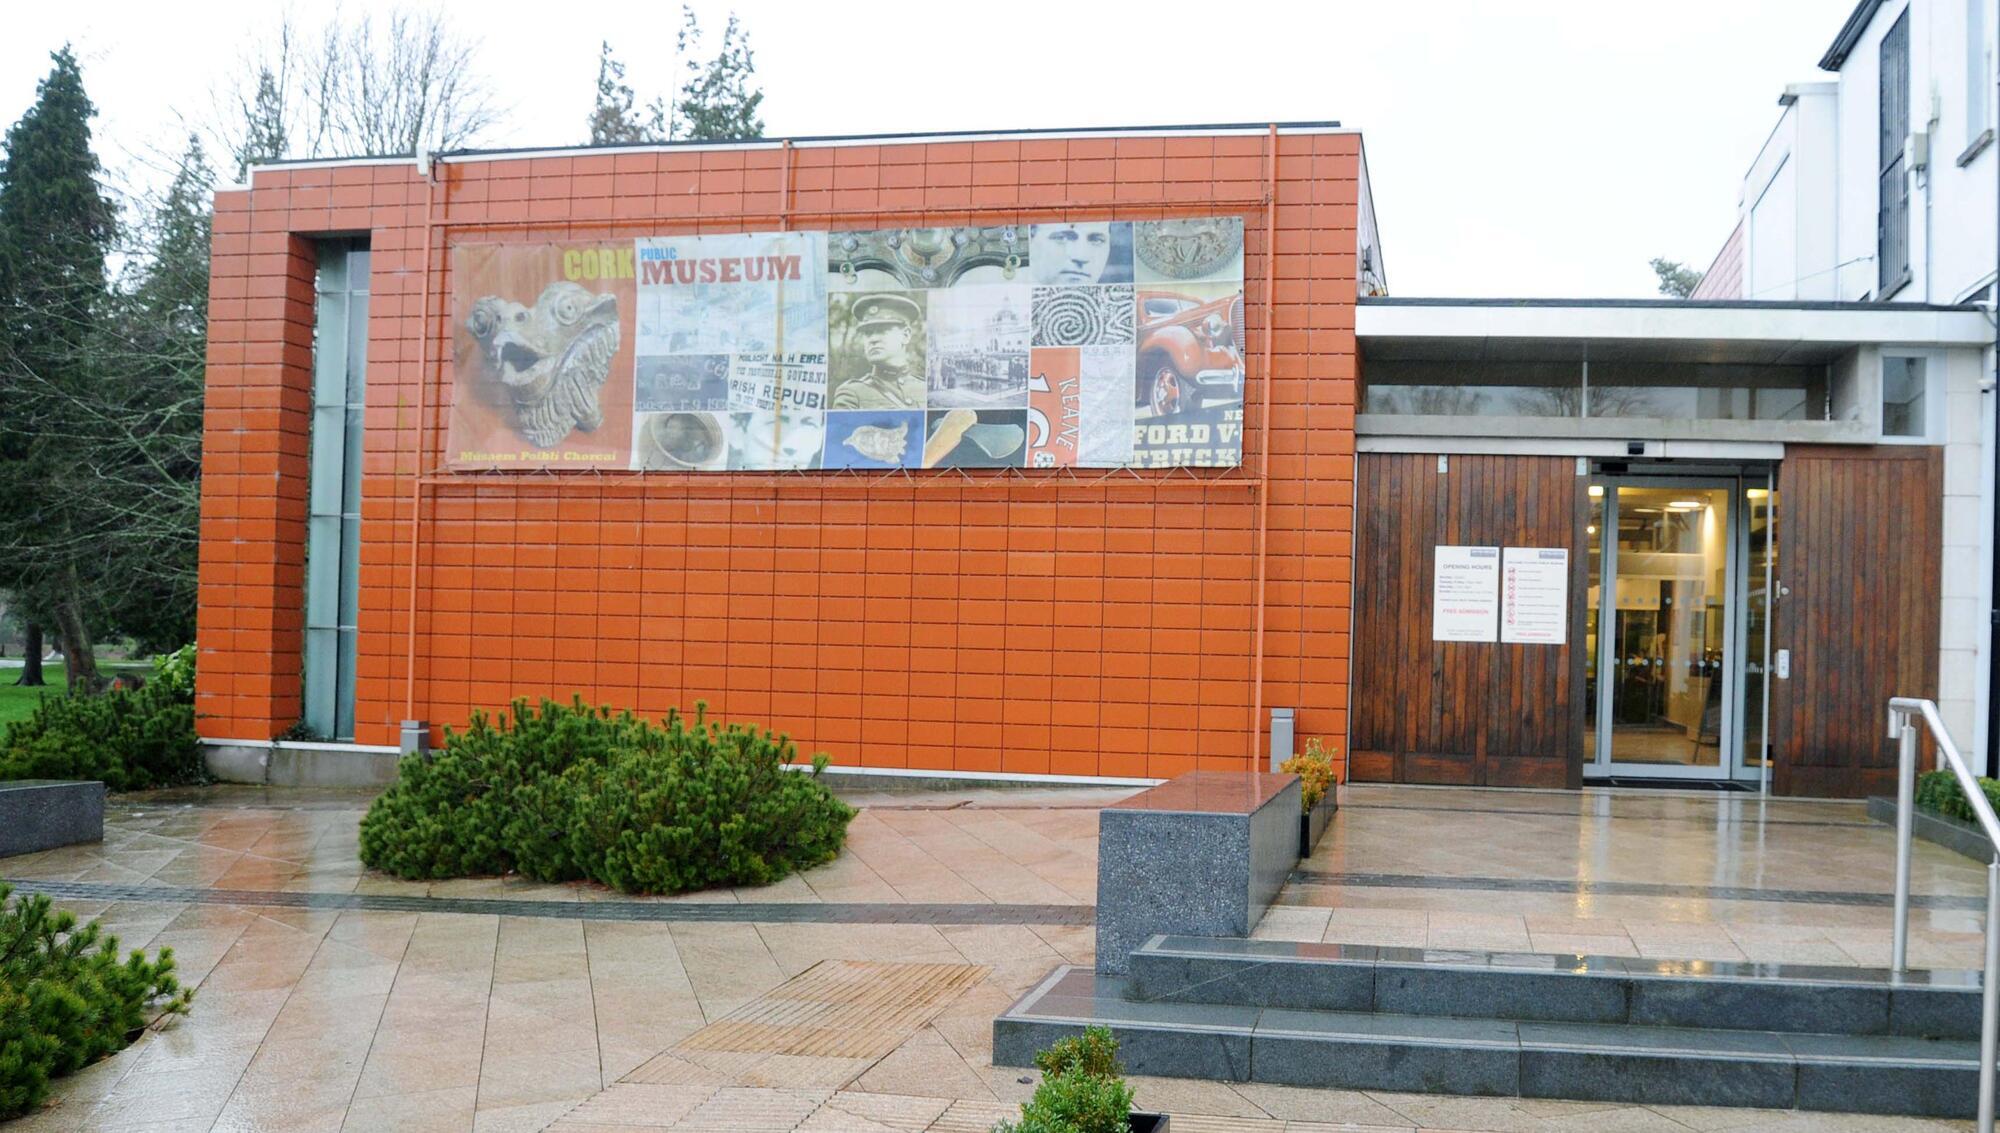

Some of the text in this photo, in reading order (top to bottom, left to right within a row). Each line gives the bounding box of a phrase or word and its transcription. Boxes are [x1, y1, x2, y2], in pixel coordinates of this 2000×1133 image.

[563, 248, 635, 281] CORK
[640, 247, 678, 260] PUBLIC
[641, 255, 802, 285] MUSEUM
[1056, 377, 1081, 452] KEANE
[1134, 424, 1211, 446] FORD
[1134, 448, 1239, 469] TRUCK
